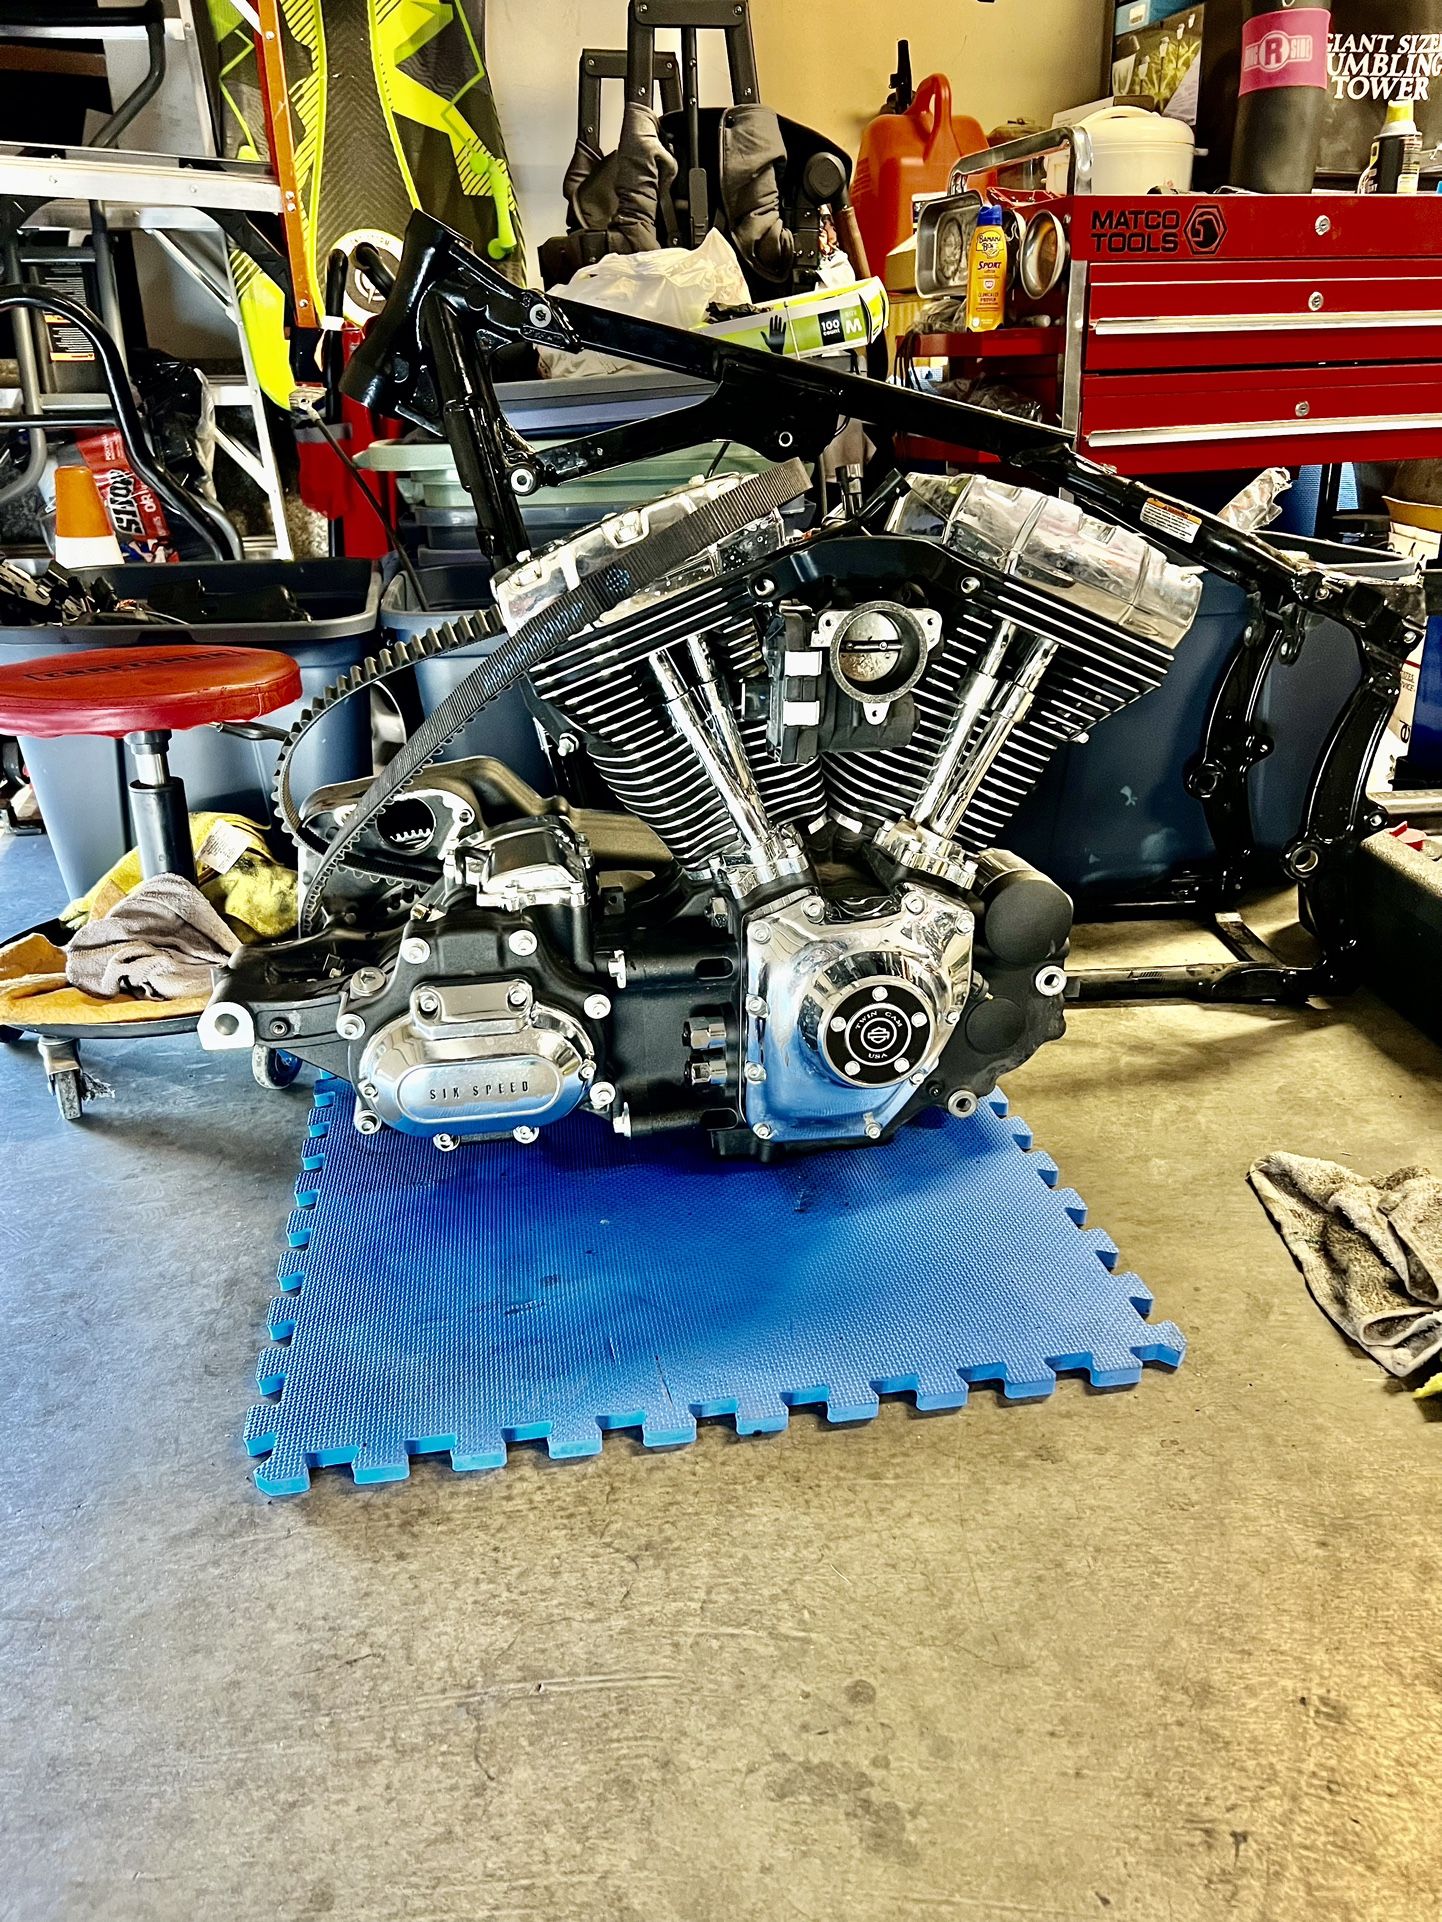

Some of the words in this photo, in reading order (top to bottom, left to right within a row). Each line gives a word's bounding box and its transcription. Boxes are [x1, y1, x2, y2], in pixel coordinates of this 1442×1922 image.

[1397, 34, 1442, 54] SIZE
[1327, 53, 1442, 77] UMBLING
[1331, 76, 1430, 100] TOWER
[1091, 209, 1181, 231] MATCO
[1090, 231, 1180, 253] TOOLS
[977, 261, 1002, 270] SPORT
[821, 319, 840, 331] 100
[846, 317, 863, 334] M
[855, 1011, 877, 1030] TWIN
[884, 1011, 903, 1027] CAM
[868, 1052, 888, 1060] USA
[430, 1087, 460, 1100] SIX
[472, 1081, 529, 1096] SPEED
